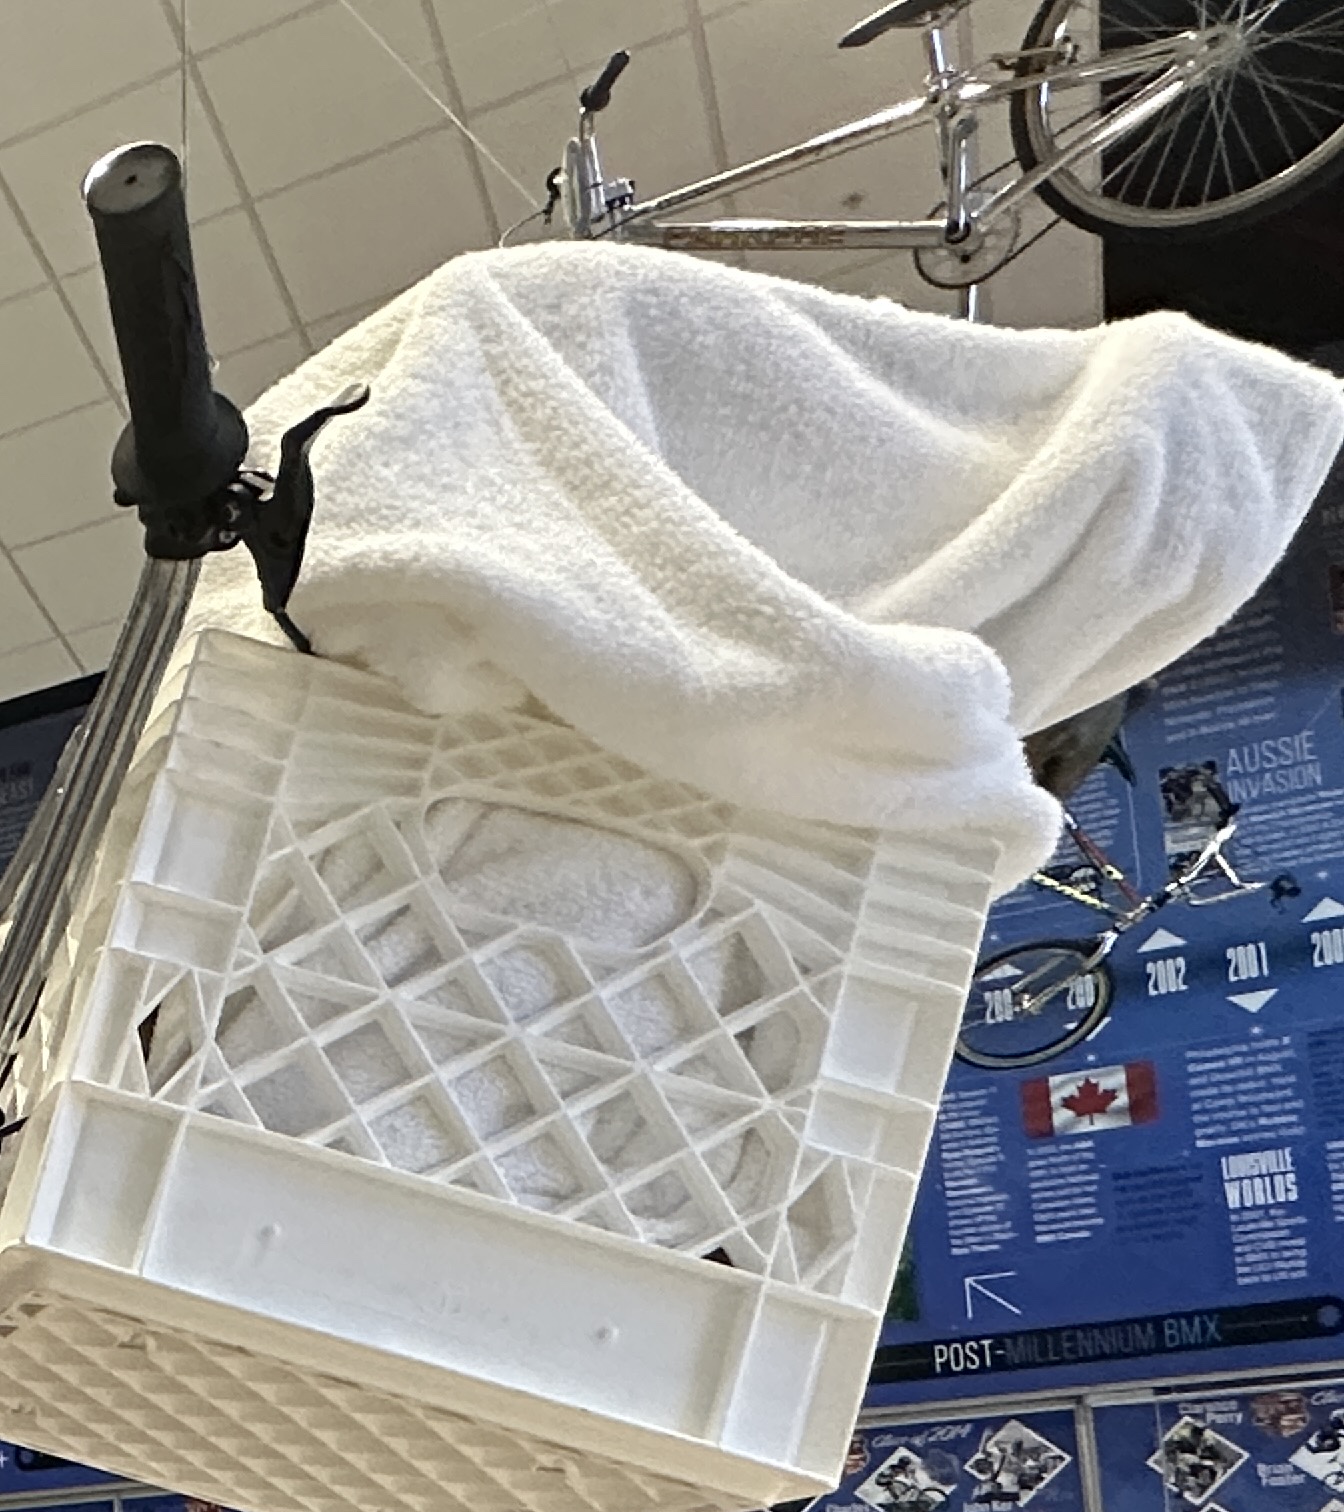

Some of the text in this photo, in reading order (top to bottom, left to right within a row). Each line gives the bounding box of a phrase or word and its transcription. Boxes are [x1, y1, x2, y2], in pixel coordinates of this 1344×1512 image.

[1226, 732, 1317, 774] AUSSIE
[1227, 765, 1323, 801] INVASION
[1146, 958, 1187, 995] 2002
[1226, 942, 1269, 982] 2001
[1223, 1174, 1299, 1210] WORLDS
[1163, 1314, 1222, 1348] BMX
